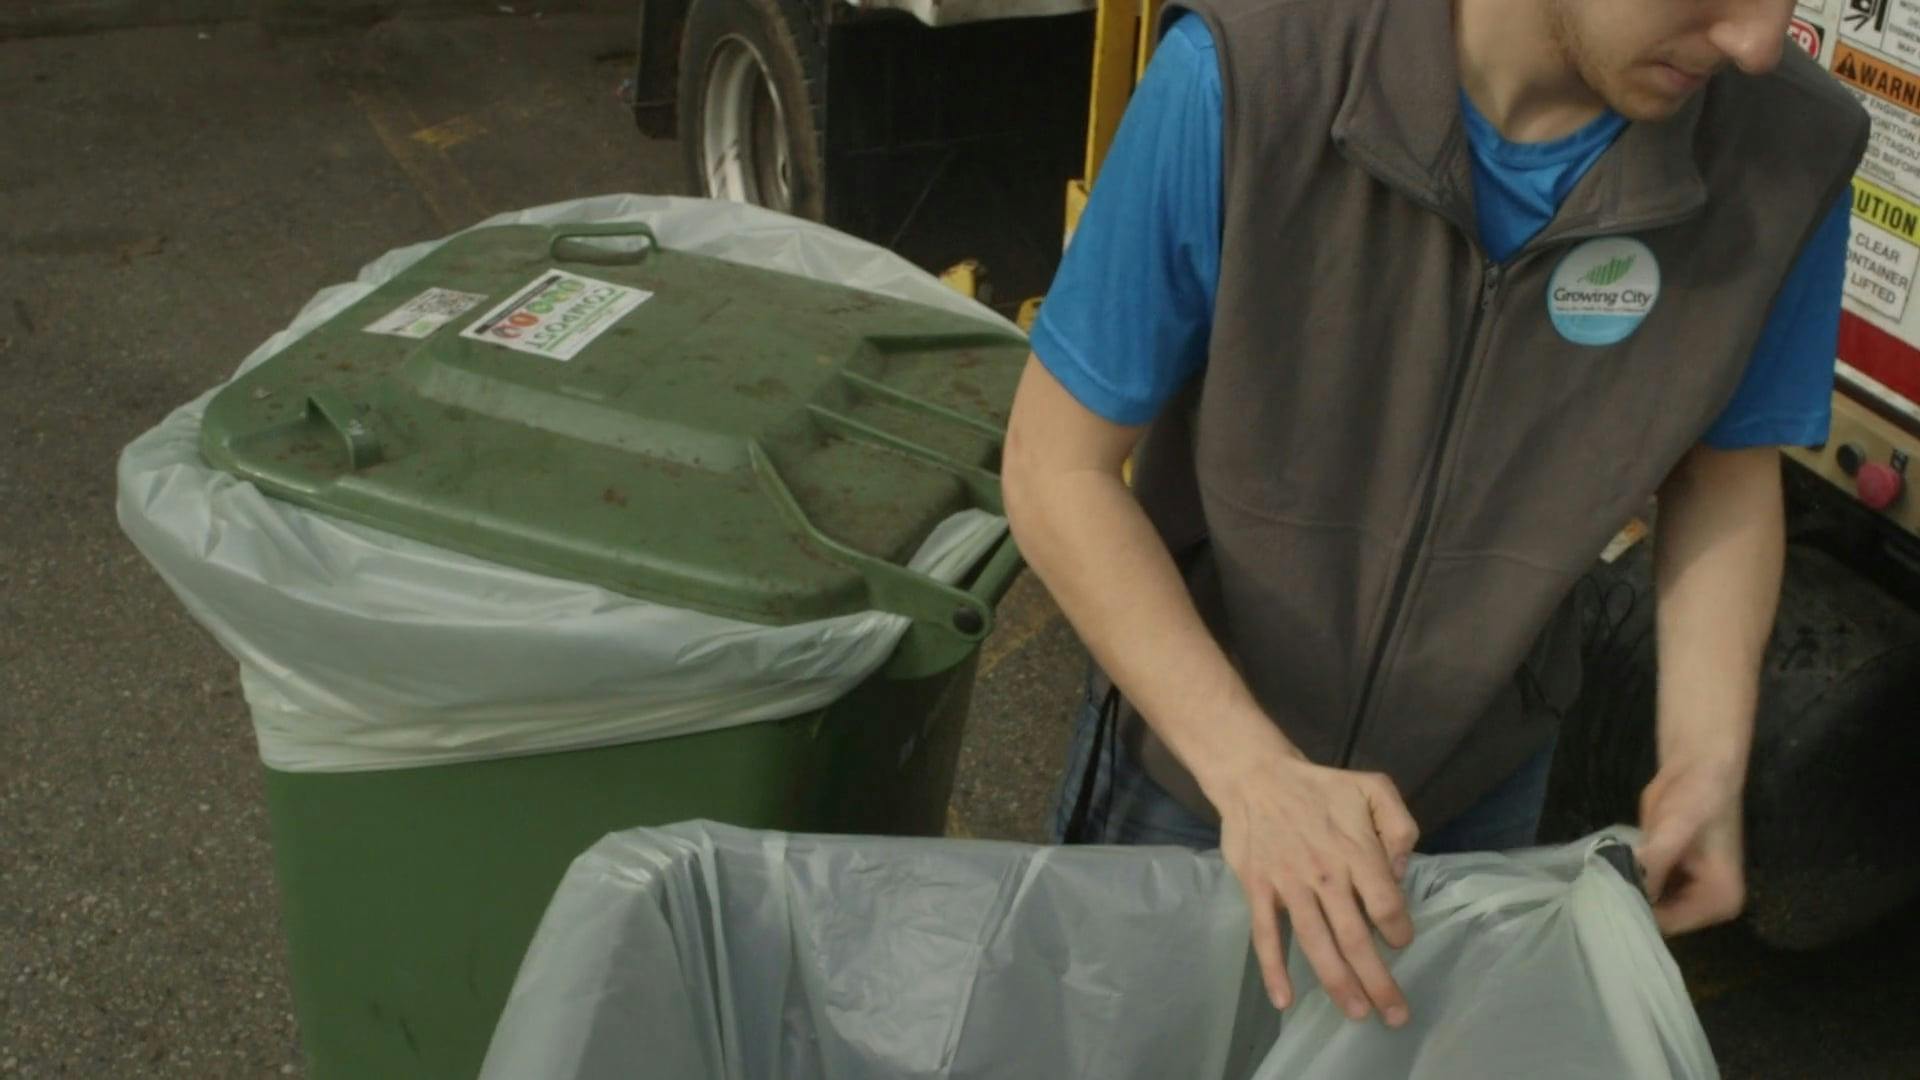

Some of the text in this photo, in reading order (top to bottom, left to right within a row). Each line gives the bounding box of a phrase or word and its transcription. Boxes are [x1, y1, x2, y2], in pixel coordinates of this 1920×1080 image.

[1855, 232, 1900, 263] CLEAR
[1554, 288, 1652, 307] Growing City
[1851, 272, 1896, 304] LIFTED
[524, 286, 617, 350] COMPOST
